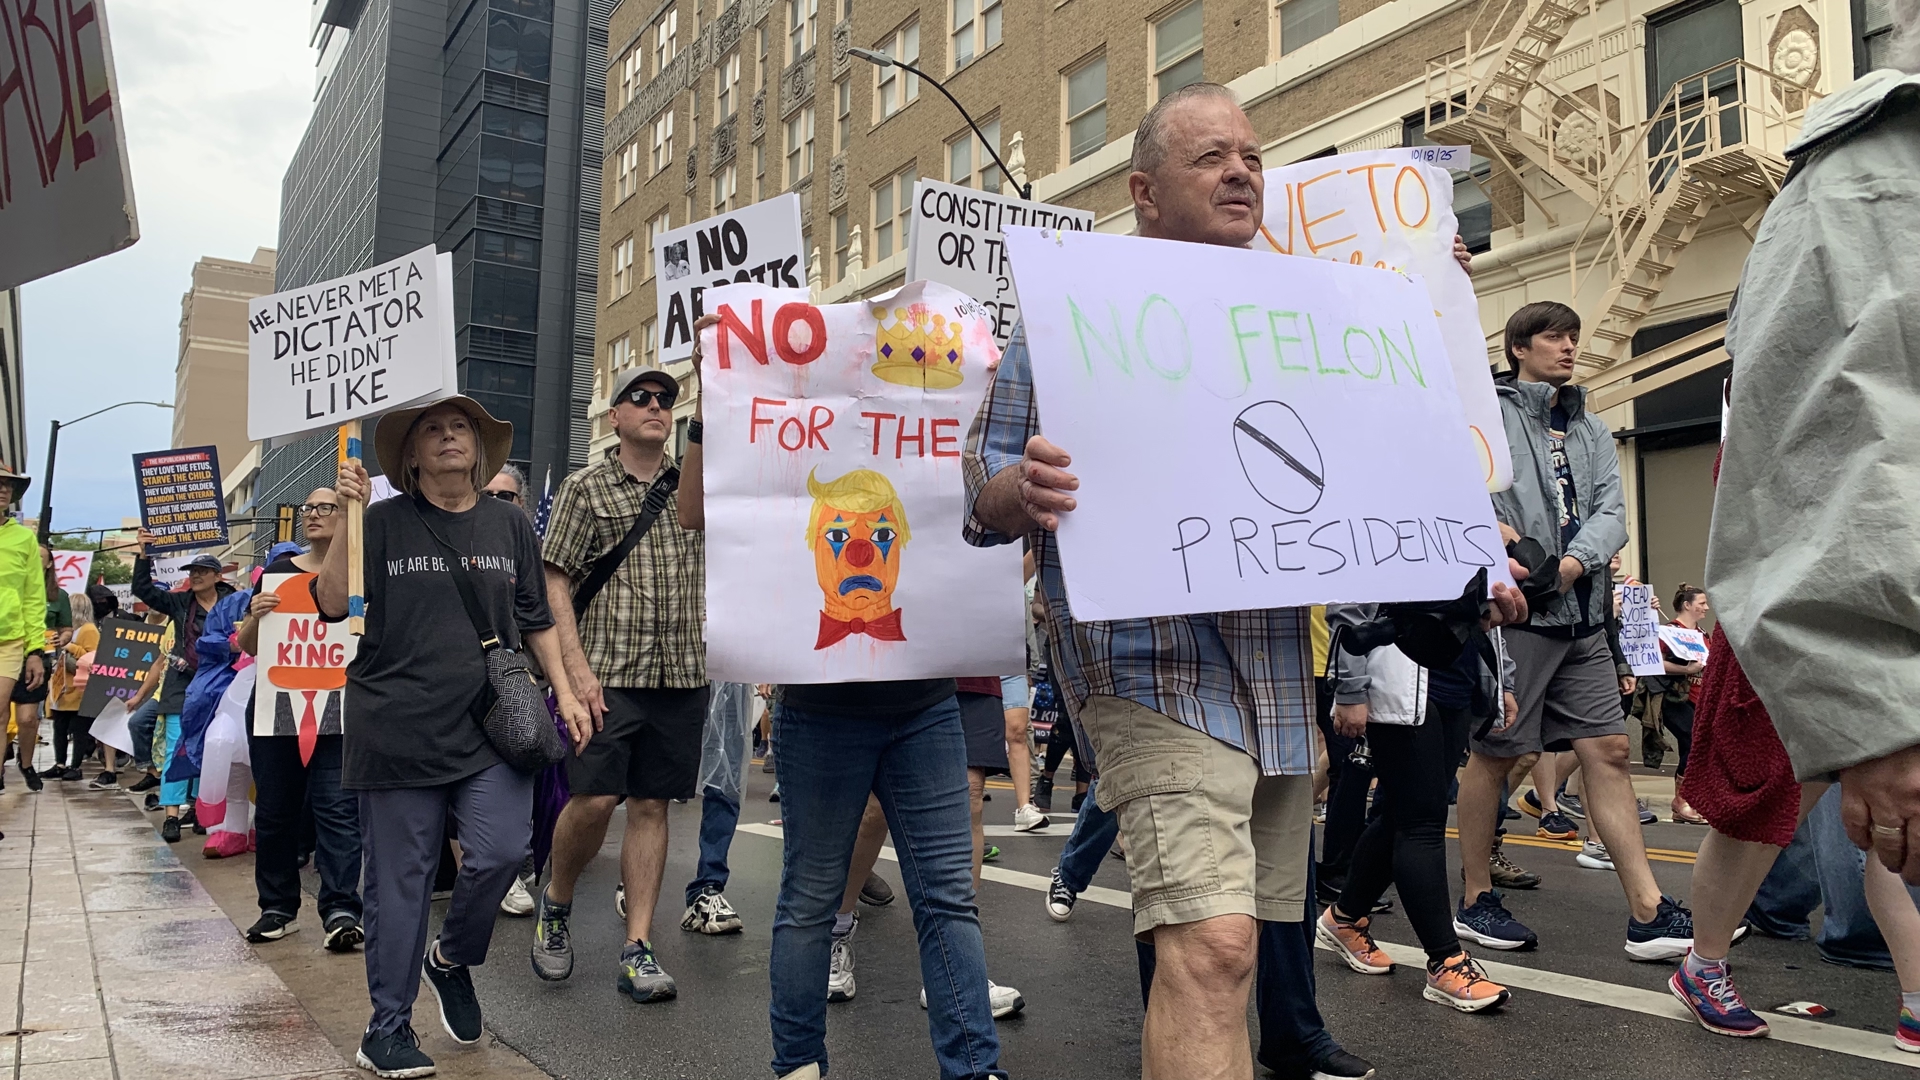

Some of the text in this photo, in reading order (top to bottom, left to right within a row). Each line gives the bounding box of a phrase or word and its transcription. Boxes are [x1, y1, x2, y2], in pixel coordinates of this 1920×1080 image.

[1410, 149, 1457, 162] 10/18/25
[1259, 163, 1430, 255] VETO
[696, 218, 748, 275] NO
[938, 231, 976, 271] OR
[249, 261, 423, 334] HE NEVER MET A
[995, 276, 1009, 299] ?
[273, 290, 424, 361] DICTATOR
[716, 298, 827, 370] NO
[1066, 293, 1428, 389] NO FELON
[291, 334, 399, 386] HE DIDN'T
[306, 368, 388, 420] LIKE
[750, 396, 960, 459] FOR THE
[141, 462, 213, 477] THEY LOVE THE FETUS,
[142, 471, 214, 486] STARVE THE CHILD.
[144, 482, 215, 497] THEY LOVE THE SOLDIER,
[146, 491, 216, 505] ABANDON THE VETERAN.
[147, 500, 218, 516] THEY LOVE THE CORPORATIONS,
[147, 509, 218, 526] FLEECE THE WORKER
[149, 520, 221, 536] THEY LOVE THE BIBLE,
[153, 535, 177, 546] GNORE
[178, 534, 192, 542] THE
[1172, 516, 1495, 593] PRESIDENTS
[161, 566, 175, 574] NO
[387, 559, 405, 577] WE
[407, 556, 429, 573] ARE
[1623, 586, 1649, 605] READ
[1622, 606, 1649, 622] VOTE
[288, 618, 327, 643] NO
[114, 647, 153, 663] IS A
[277, 642, 344, 668] KING
[1640, 642, 1654, 653] you
[1642, 652, 1660, 665] CAN
